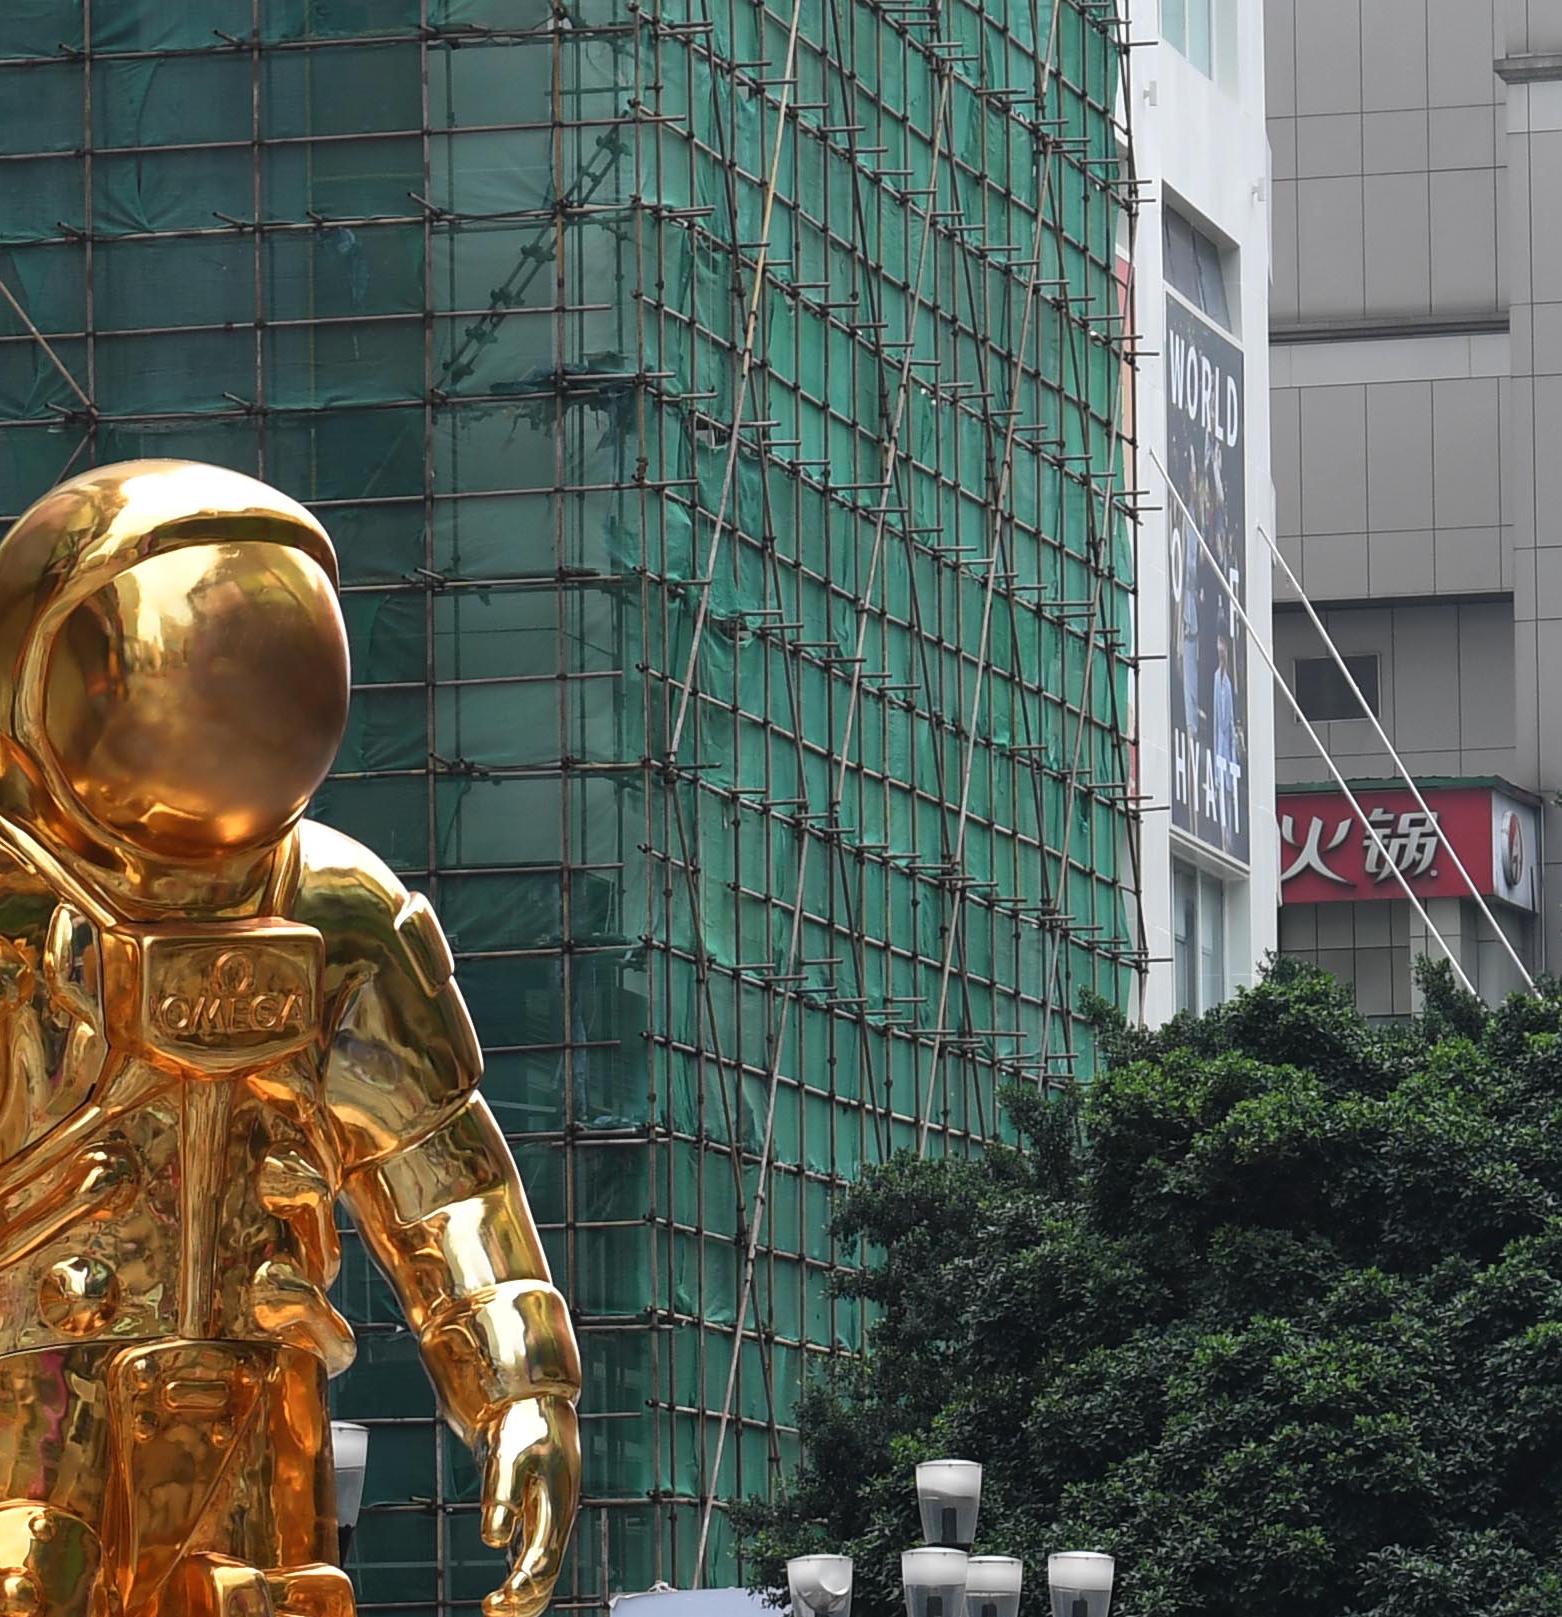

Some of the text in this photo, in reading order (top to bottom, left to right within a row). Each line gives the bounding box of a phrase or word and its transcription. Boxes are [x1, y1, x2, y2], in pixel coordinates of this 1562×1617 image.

[1169, 329, 1238, 448] WORLD
[1173, 726, 1241, 833] HYATT
[1280, 807, 1438, 888] 火锅
[160, 991, 307, 1037] OMEGA
